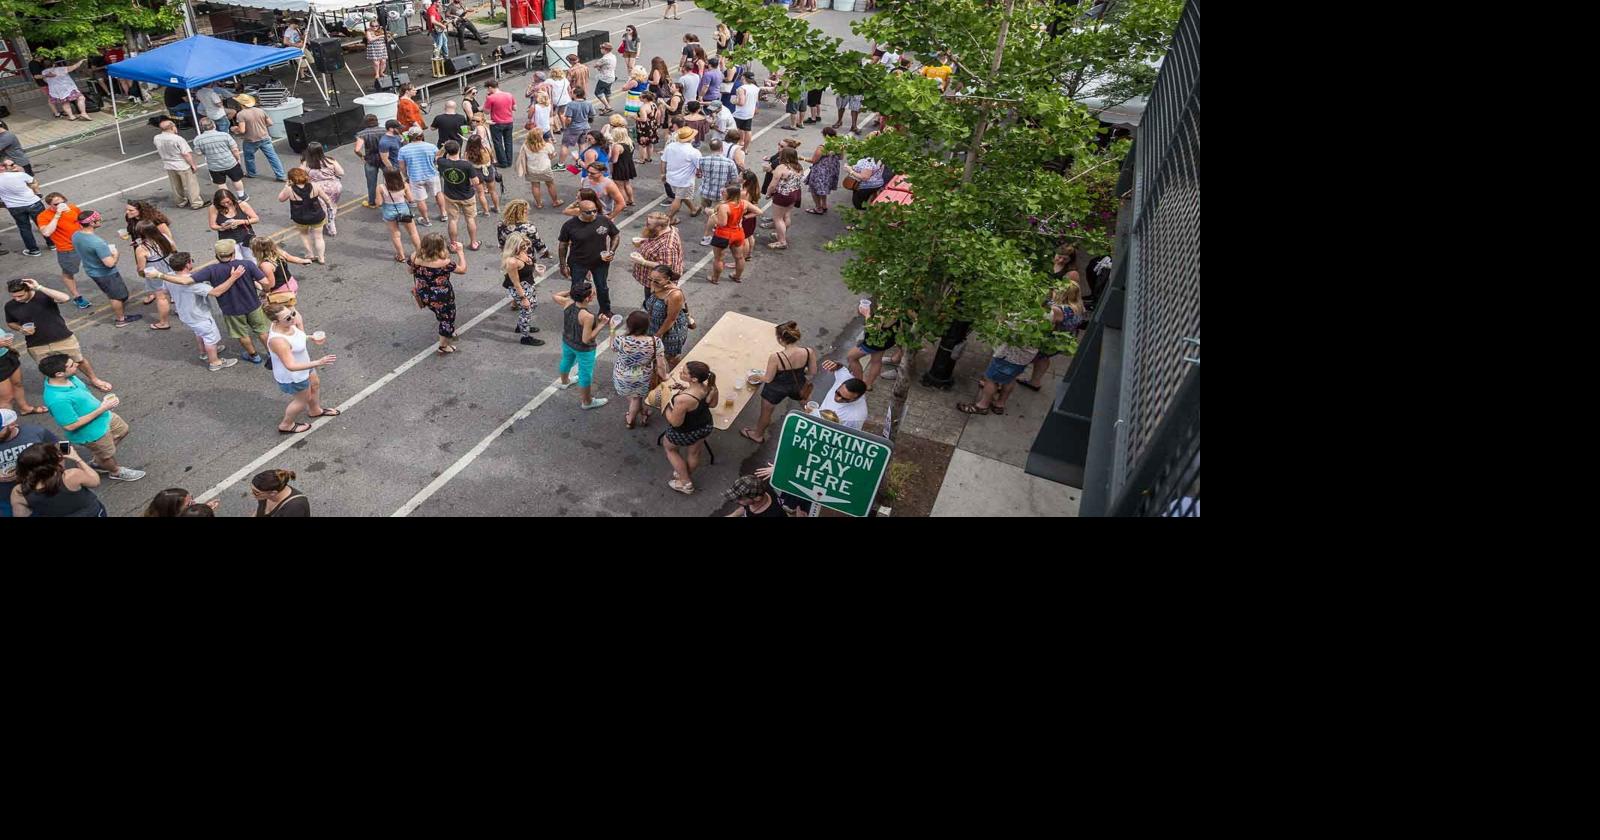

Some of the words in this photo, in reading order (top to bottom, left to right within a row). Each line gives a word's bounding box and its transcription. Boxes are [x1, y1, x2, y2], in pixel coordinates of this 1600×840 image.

[792, 434, 817, 451] PAY
[821, 444, 873, 471] STATION
[795, 419, 879, 457] PARKING
[796, 465, 853, 495] HERE
[806, 453, 850, 477] PAY
